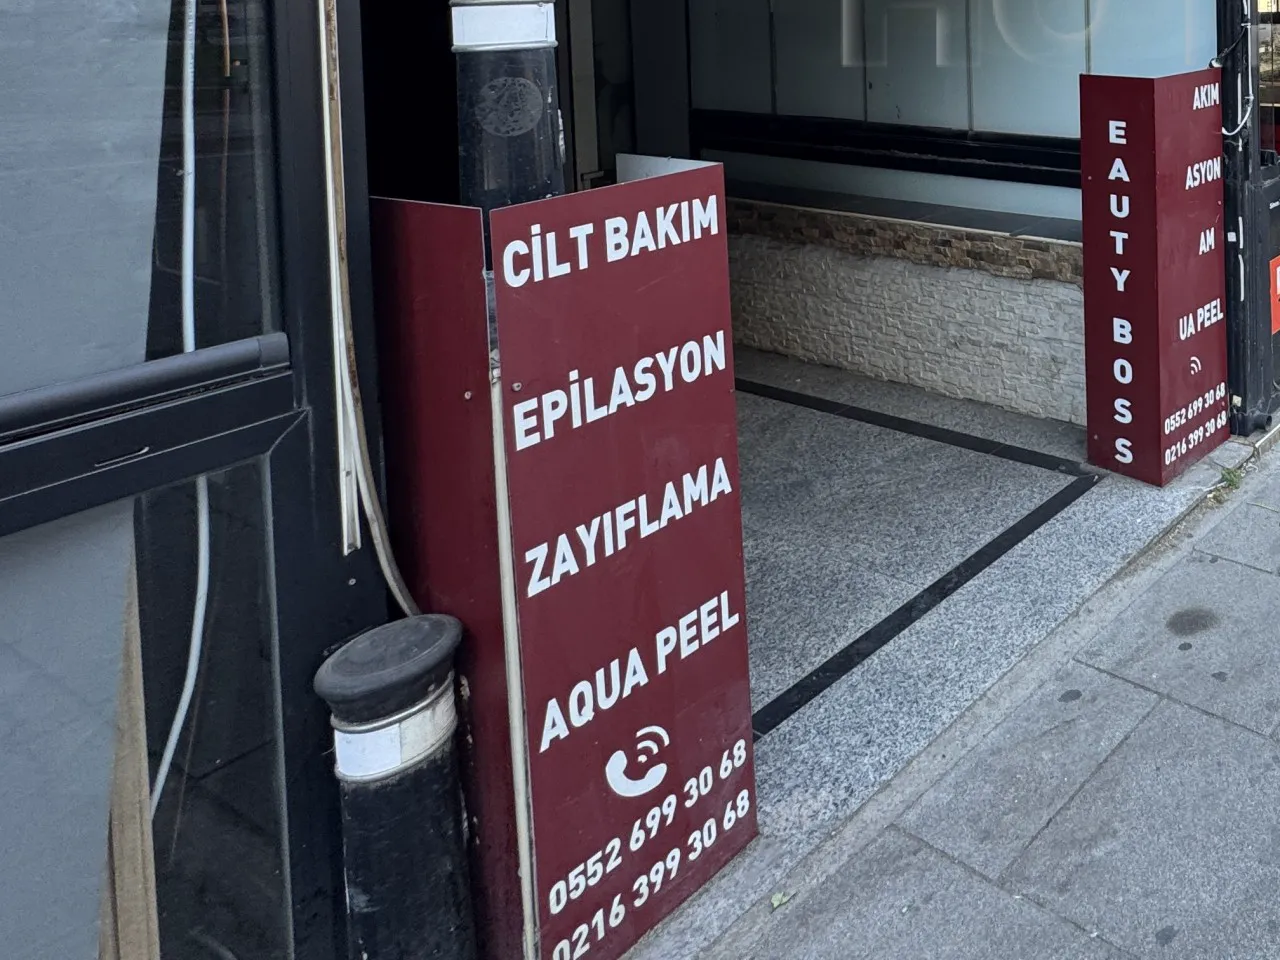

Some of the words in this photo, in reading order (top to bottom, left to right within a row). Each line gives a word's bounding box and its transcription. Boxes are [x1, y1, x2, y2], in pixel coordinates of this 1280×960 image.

[1193, 83, 1219, 111] AKIM
[1185, 157, 1221, 190] ASYON
[502, 223, 595, 289] CİLT
[606, 194, 720, 264] BAKIM
[1178, 313, 1197, 341] UA
[1197, 298, 1224, 330] PEEL
[512, 330, 727, 453] EPİLASYON
[1164, 408, 1187, 435] 0552
[1187, 396, 1203, 420] 699
[1204, 389, 1215, 409] 30
[1215, 382, 1226, 400] 68
[1165, 437, 1187, 466] 0216
[1188, 426, 1204, 450] 399
[1205, 418, 1216, 437] 30
[1216, 410, 1227, 429] 68
[525, 457, 733, 598] ZAYIFLAMA
[539, 646, 649, 754] AQUA
[655, 590, 740, 676] PEEL
[549, 837, 623, 915] 0552
[629, 794, 677, 852] 699
[683, 765, 713, 808] 30
[719, 739, 747, 779] 68
[552, 893, 626, 960] 0216
[632, 848, 681, 908] 399
[687, 817, 717, 861] 30
[723, 789, 750, 830] 68
